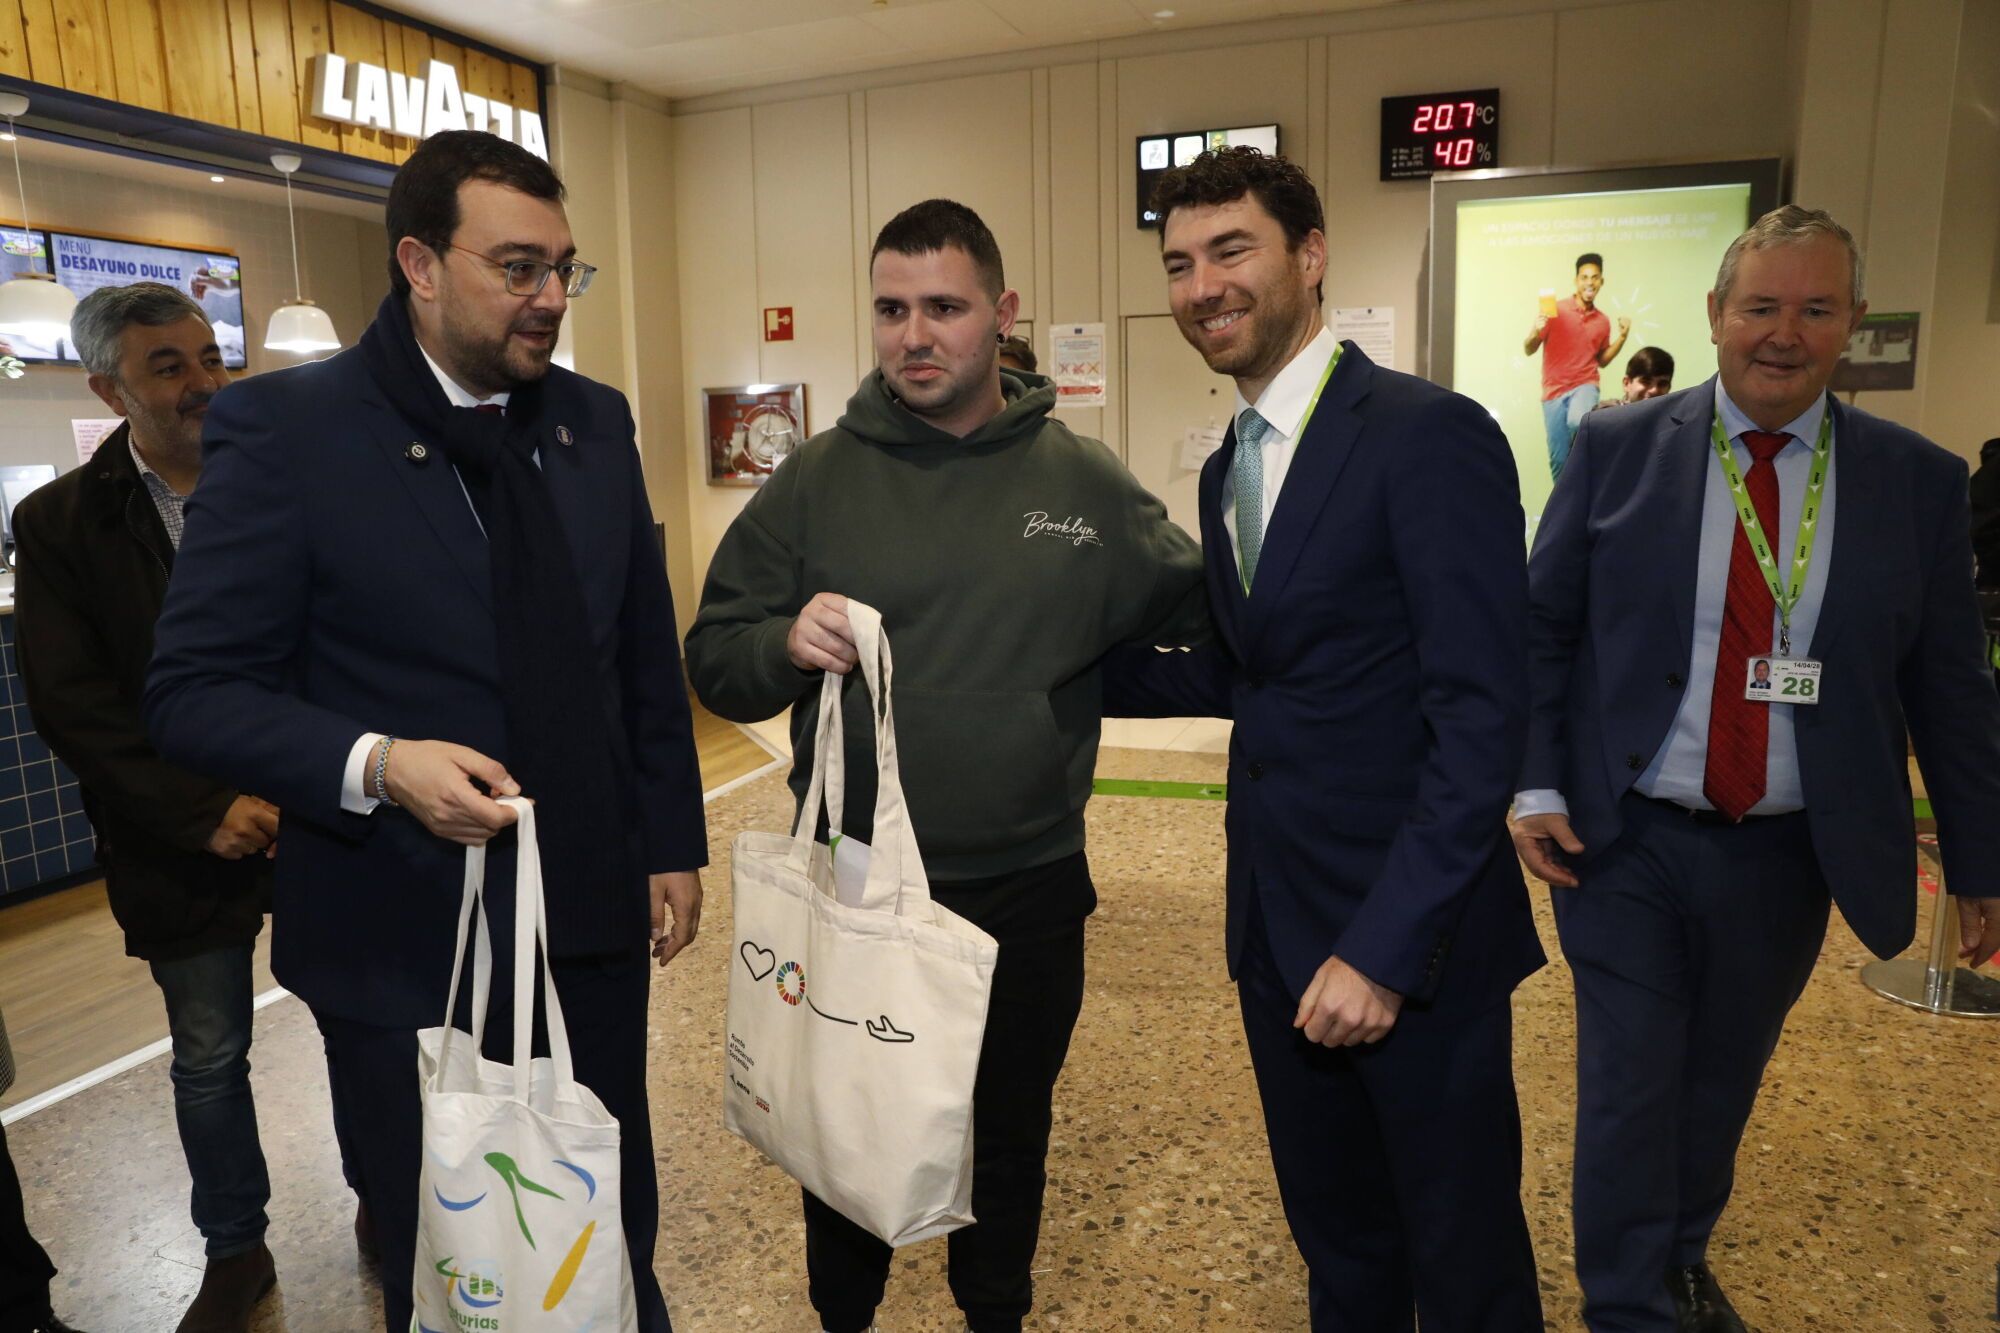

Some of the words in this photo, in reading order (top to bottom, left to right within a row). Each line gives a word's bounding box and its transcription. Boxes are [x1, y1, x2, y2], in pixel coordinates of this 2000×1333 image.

[1435, 139, 1474, 165] 40
[1477, 143, 1492, 162] %
[1600, 217, 1615, 228] TU
[1617, 214, 1672, 227] MENSAJE
[60, 254, 137, 276] DESAYUNO
[140, 263, 181, 280] DULCE
[1023, 510, 1099, 546] Brooklyn
[1781, 676, 1815, 697] 28
